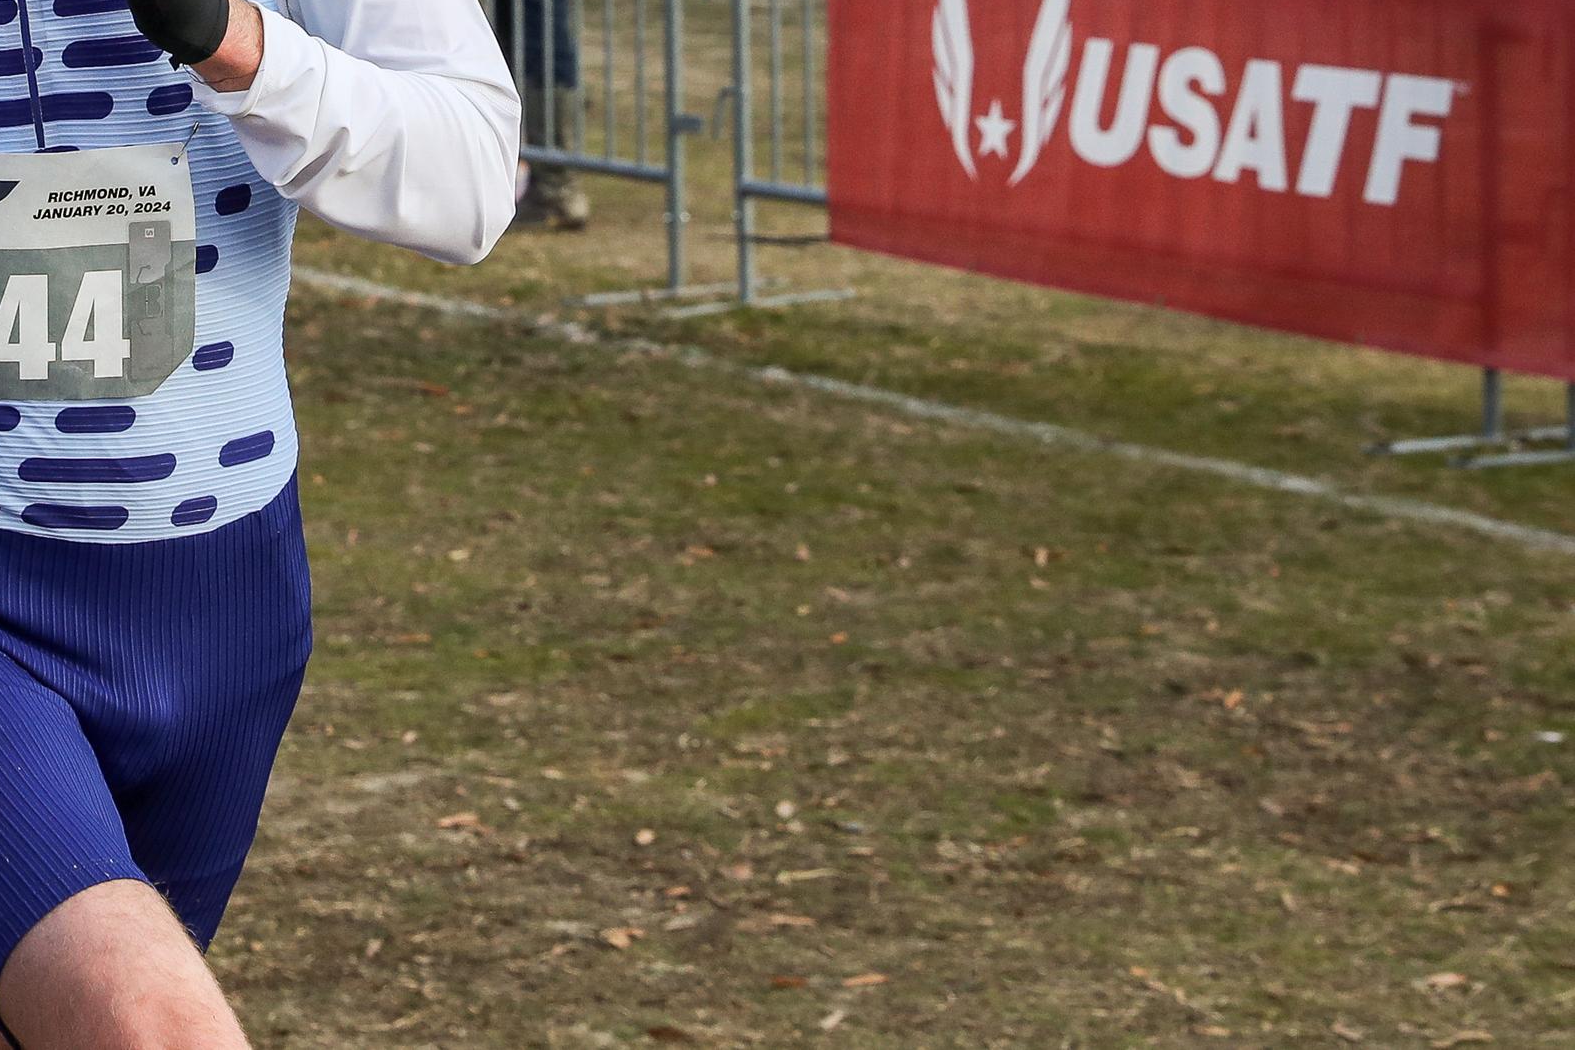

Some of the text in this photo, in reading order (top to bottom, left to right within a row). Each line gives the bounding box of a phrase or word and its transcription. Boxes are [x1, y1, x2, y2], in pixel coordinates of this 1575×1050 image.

[1067, 36, 1454, 206] USATF
[47, 185, 156, 203] RICHMOND, VA
[32, 201, 171, 220] JANUARY 20, 2024
